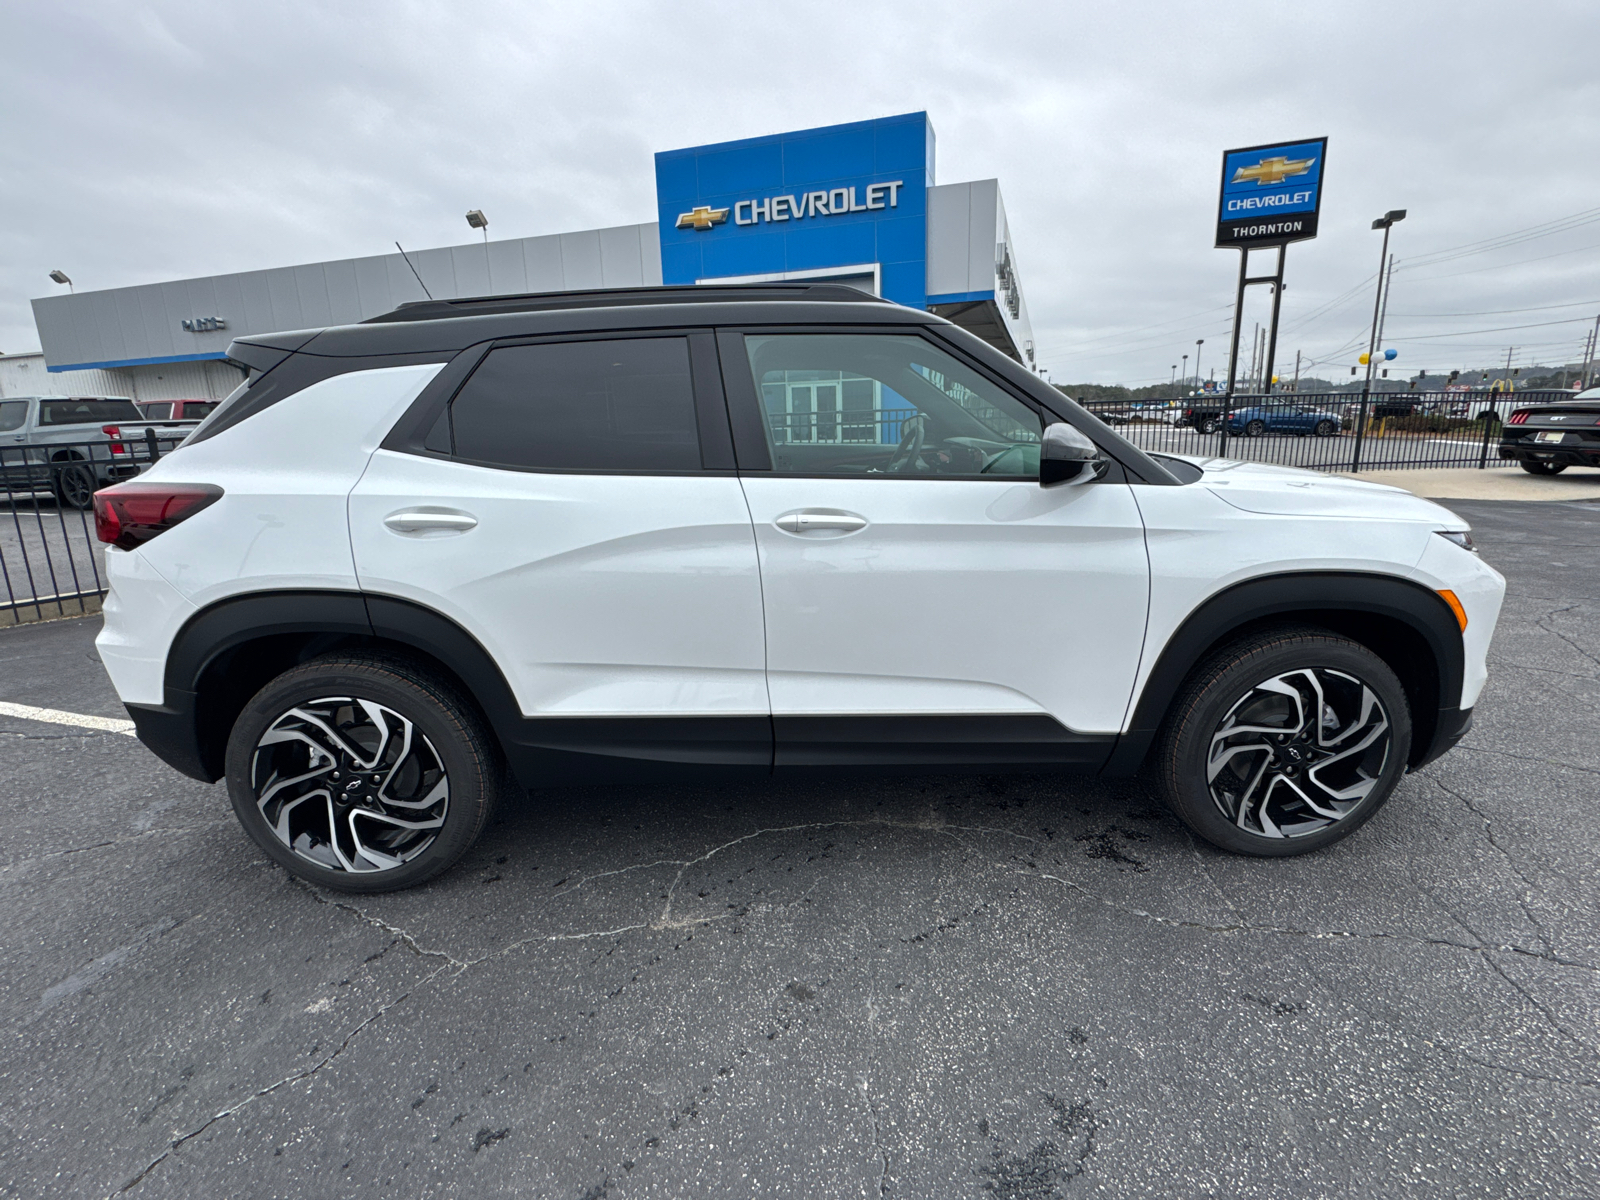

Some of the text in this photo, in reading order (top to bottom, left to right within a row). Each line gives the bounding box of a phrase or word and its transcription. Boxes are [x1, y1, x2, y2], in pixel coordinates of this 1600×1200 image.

[735, 180, 903, 225] CHEVROLET
[1227, 191, 1312, 211] CHEVROLET
[1232, 221, 1302, 237] THORNTON
